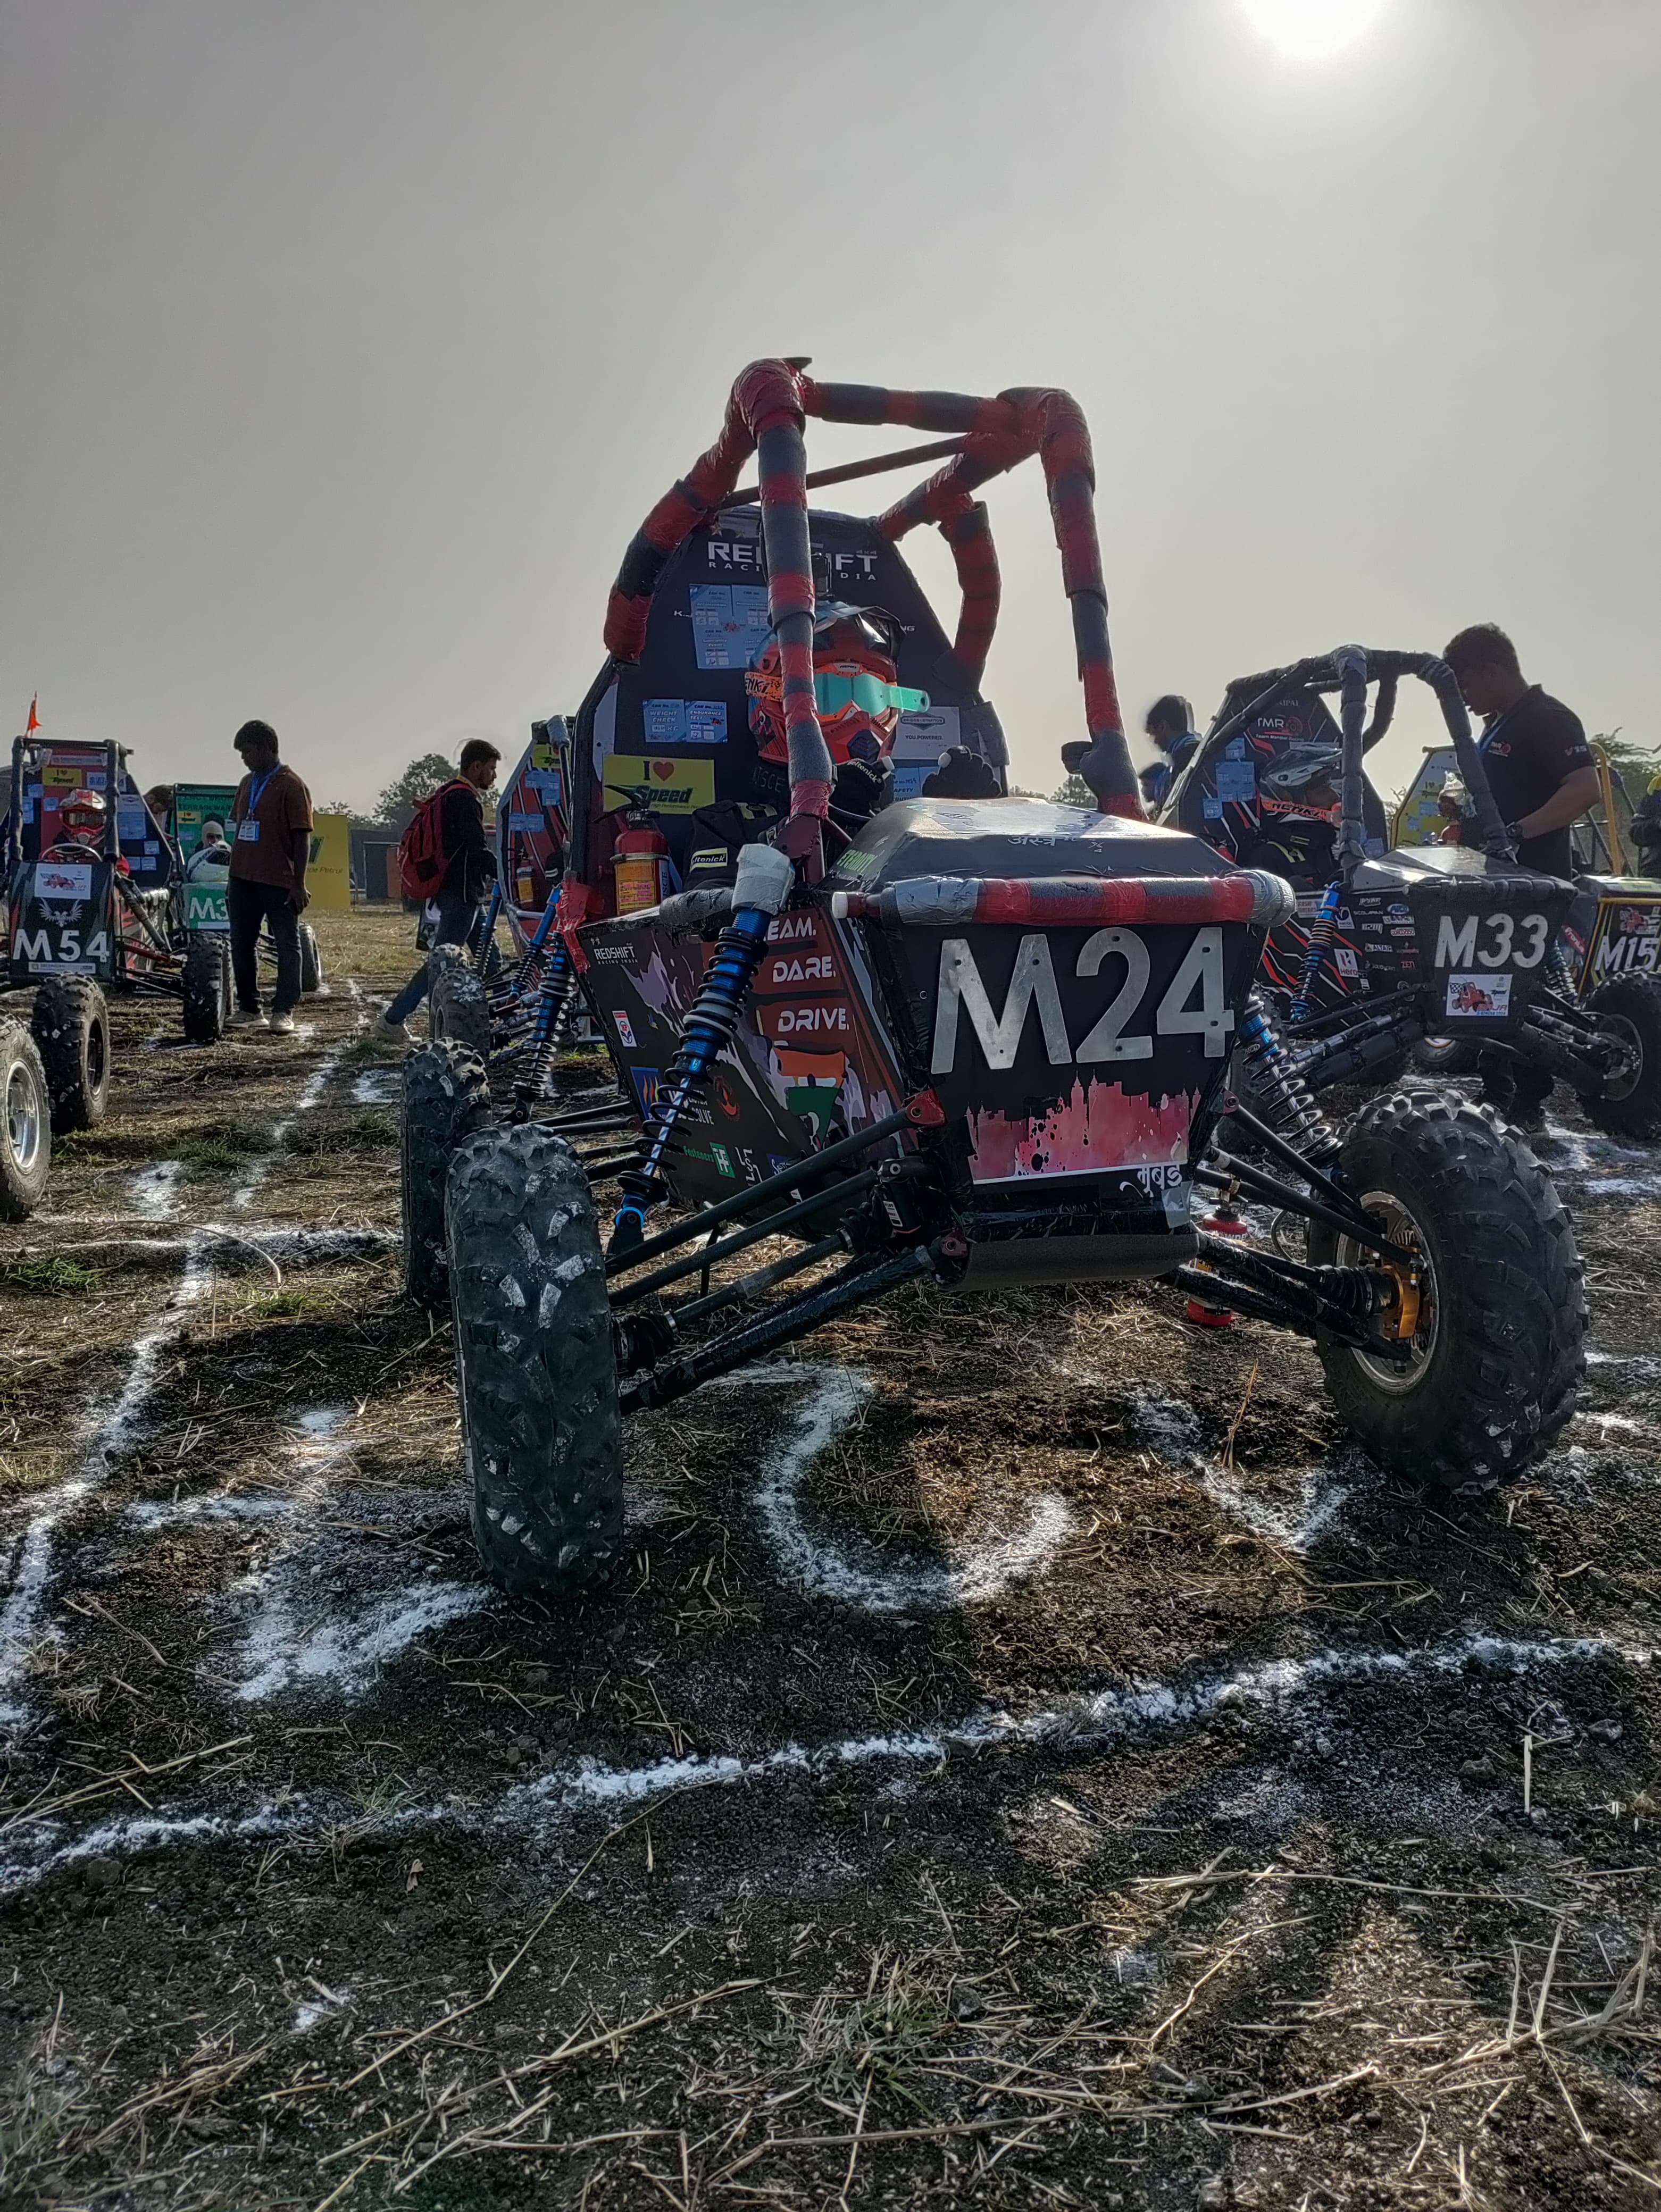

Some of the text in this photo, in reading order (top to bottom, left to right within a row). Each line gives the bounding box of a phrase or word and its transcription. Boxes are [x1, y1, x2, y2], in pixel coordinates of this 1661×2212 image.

[643, 760, 650, 781] I
[848, 760, 878, 784] eltonick
[764, 917, 817, 941] EAM.
[1434, 913, 1549, 969] M33
[594, 945, 636, 960] REDSHIFT
[772, 956, 837, 983] DARE.
[931, 926, 1236, 1075] M24
[777, 1007, 849, 1033] DRIVE.
